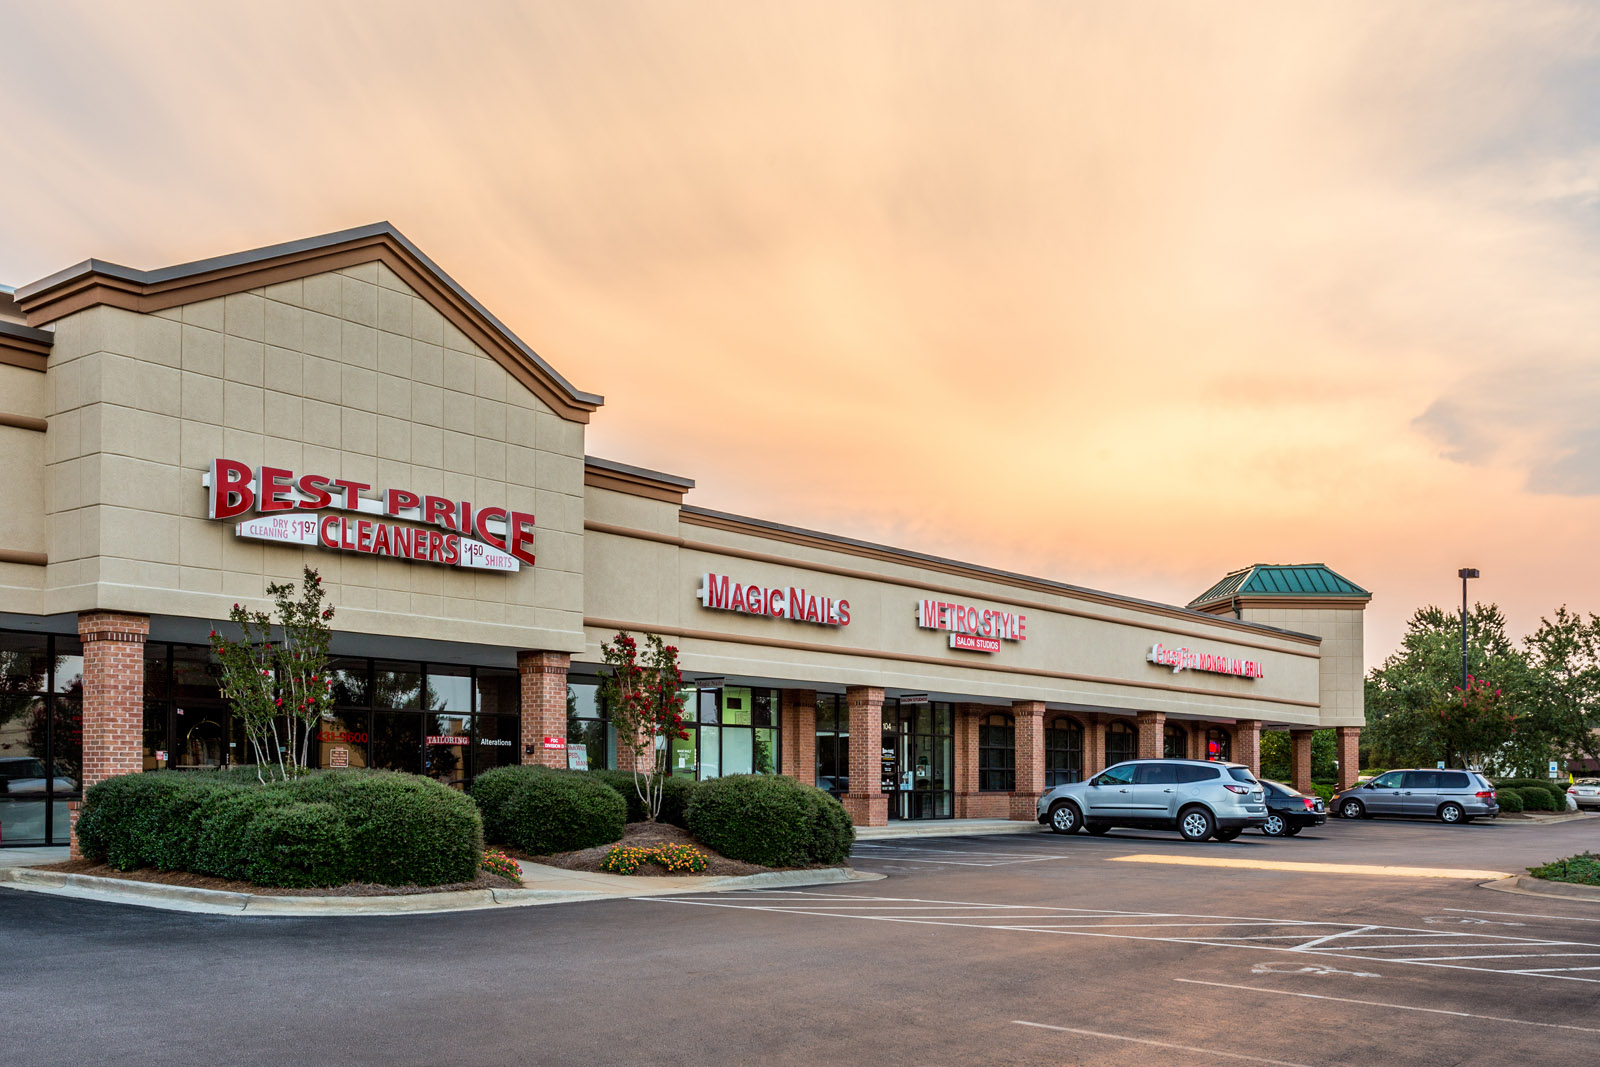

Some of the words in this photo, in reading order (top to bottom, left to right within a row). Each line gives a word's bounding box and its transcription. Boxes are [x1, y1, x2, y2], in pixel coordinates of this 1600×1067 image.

[210, 458, 371, 519] BEST
[384, 488, 536, 566] PRICE
[273, 518, 289, 529] DRY
[249, 524, 289, 539] CLEANING
[320, 515, 459, 565] CLEANERS
[485, 554, 513, 569] SHIRTS
[703, 573, 784, 617] MAGIC
[785, 586, 851, 626] NAILS
[919, 599, 978, 634] METRO
[979, 609, 1027, 641] STYLE
[956, 637, 975, 647] SALON
[976, 638, 999, 650] STUDIOS
[1200, 654, 1243, 675] MONGOLIAN
[1244, 660, 1264, 679] GRILL
[882, 722, 892, 731] 104
[480, 738, 512, 747] Alterations
